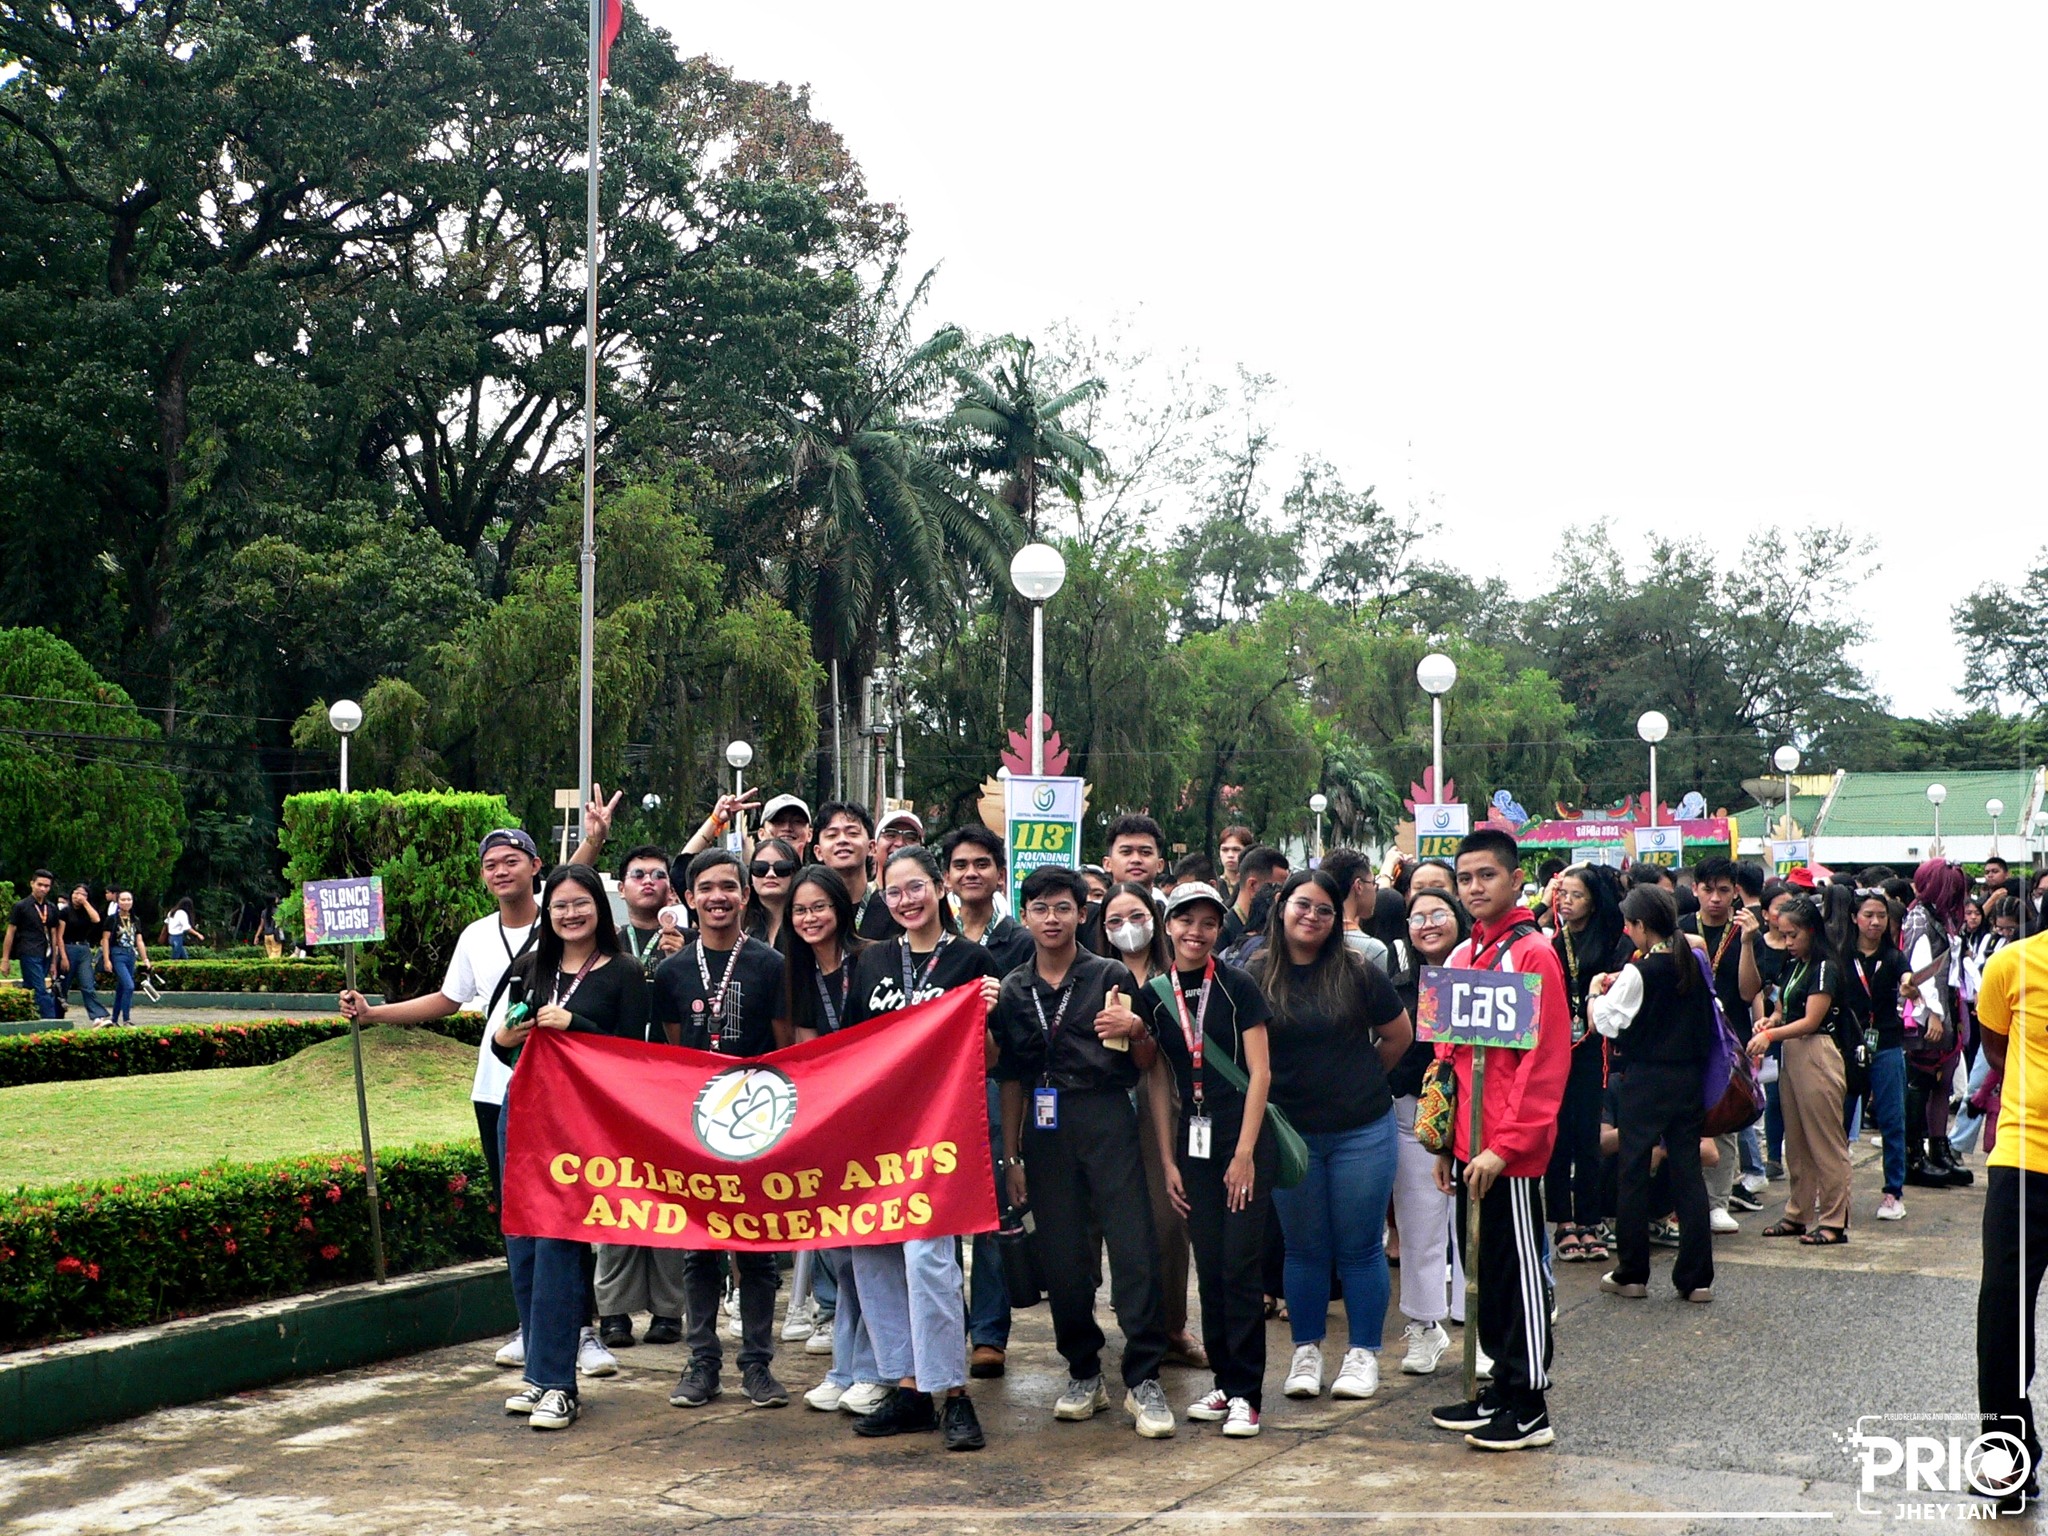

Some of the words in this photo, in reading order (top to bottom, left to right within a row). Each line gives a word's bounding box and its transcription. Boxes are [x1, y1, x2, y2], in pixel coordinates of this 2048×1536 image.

[1016, 851, 1071, 862] FOUNDING
[549, 1152, 745, 1204] COLLEGE
[762, 1166, 823, 1201] OF
[840, 1140, 958, 1192] ARTS
[583, 1195, 687, 1235] AND
[707, 1192, 933, 1241] SCIENCES
